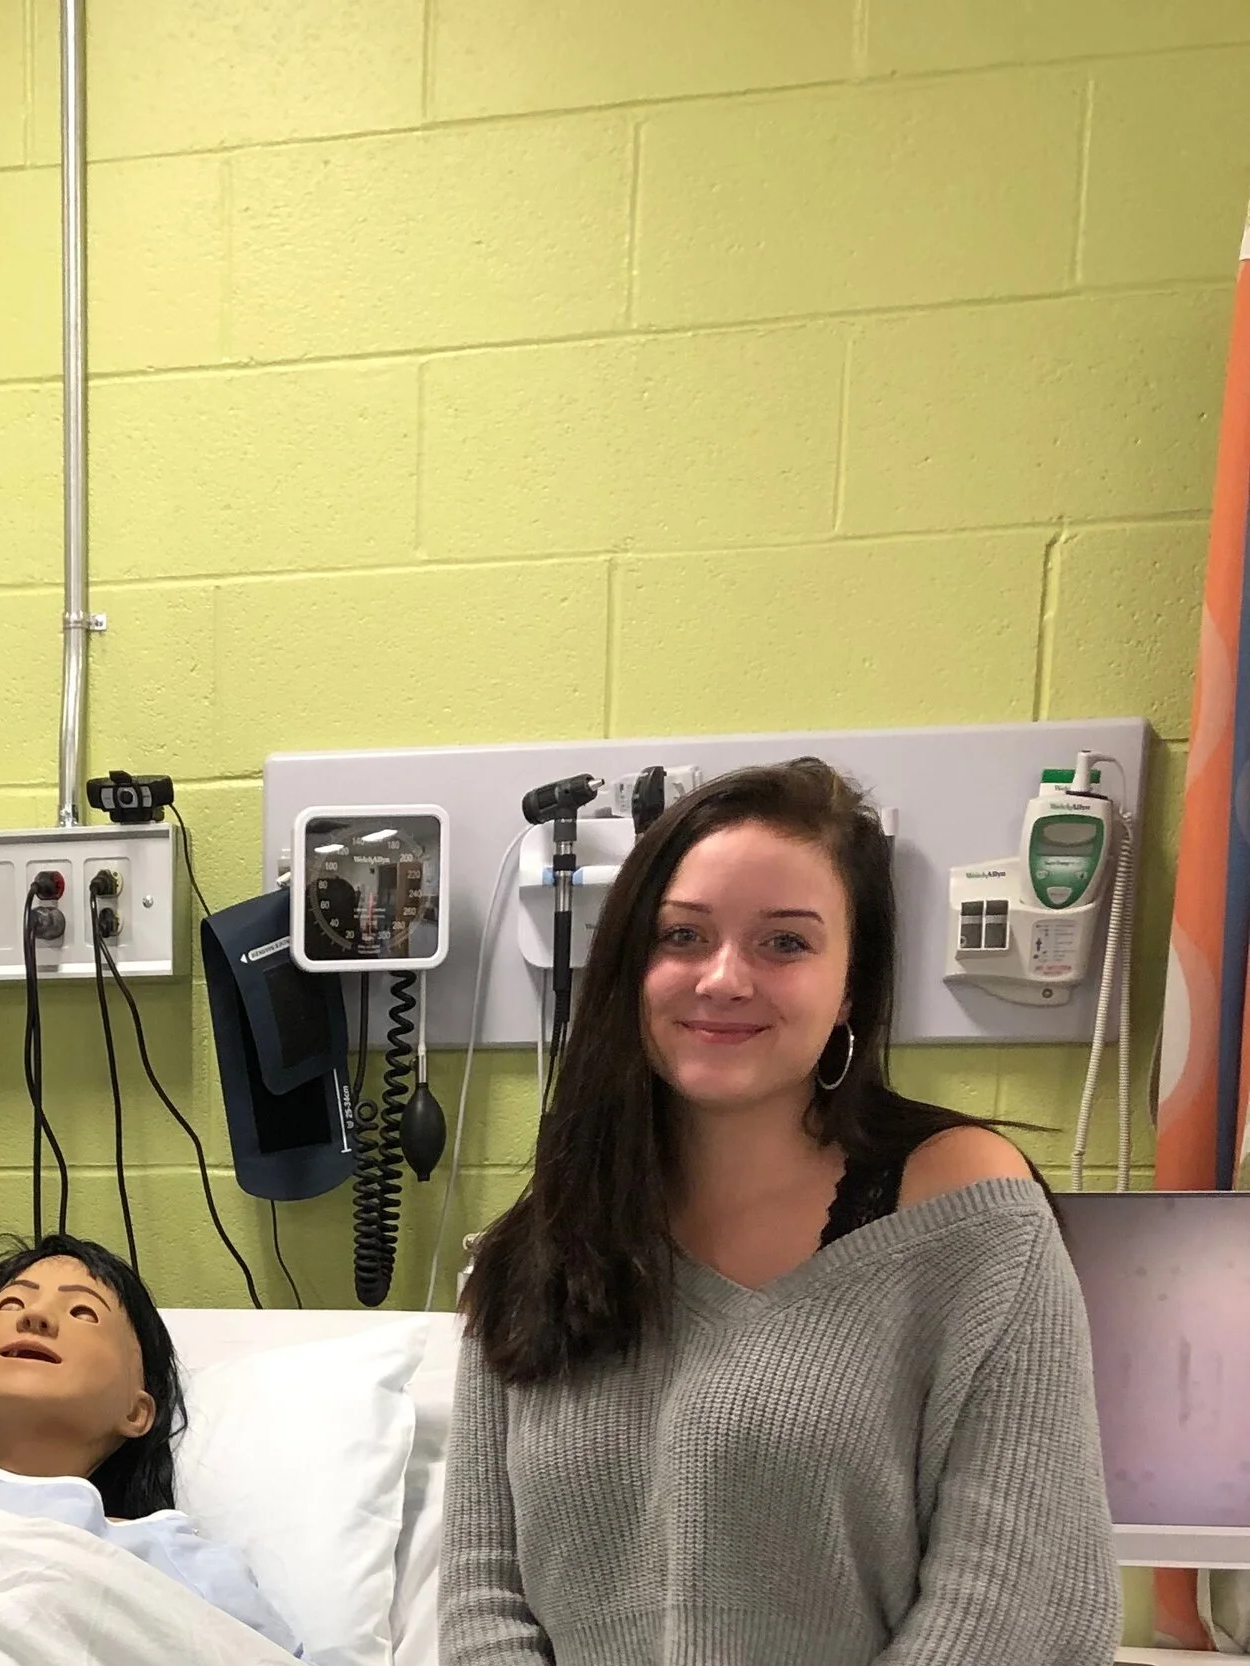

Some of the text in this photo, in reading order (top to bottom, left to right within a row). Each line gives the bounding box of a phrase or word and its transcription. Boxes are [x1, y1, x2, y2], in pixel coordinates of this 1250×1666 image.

[399, 853, 413, 862] 200
[325, 861, 338, 871] 100
[407, 870, 420, 879] 220
[318, 880, 328, 889] 80
[408, 889, 423, 898] 240
[320, 900, 330, 909] 60
[403, 907, 417, 916] 260
[330, 918, 339, 928] 40
[392, 920, 405, 930] 280
[345, 930, 355, 939] 20
[377, 930, 391, 940] 300
